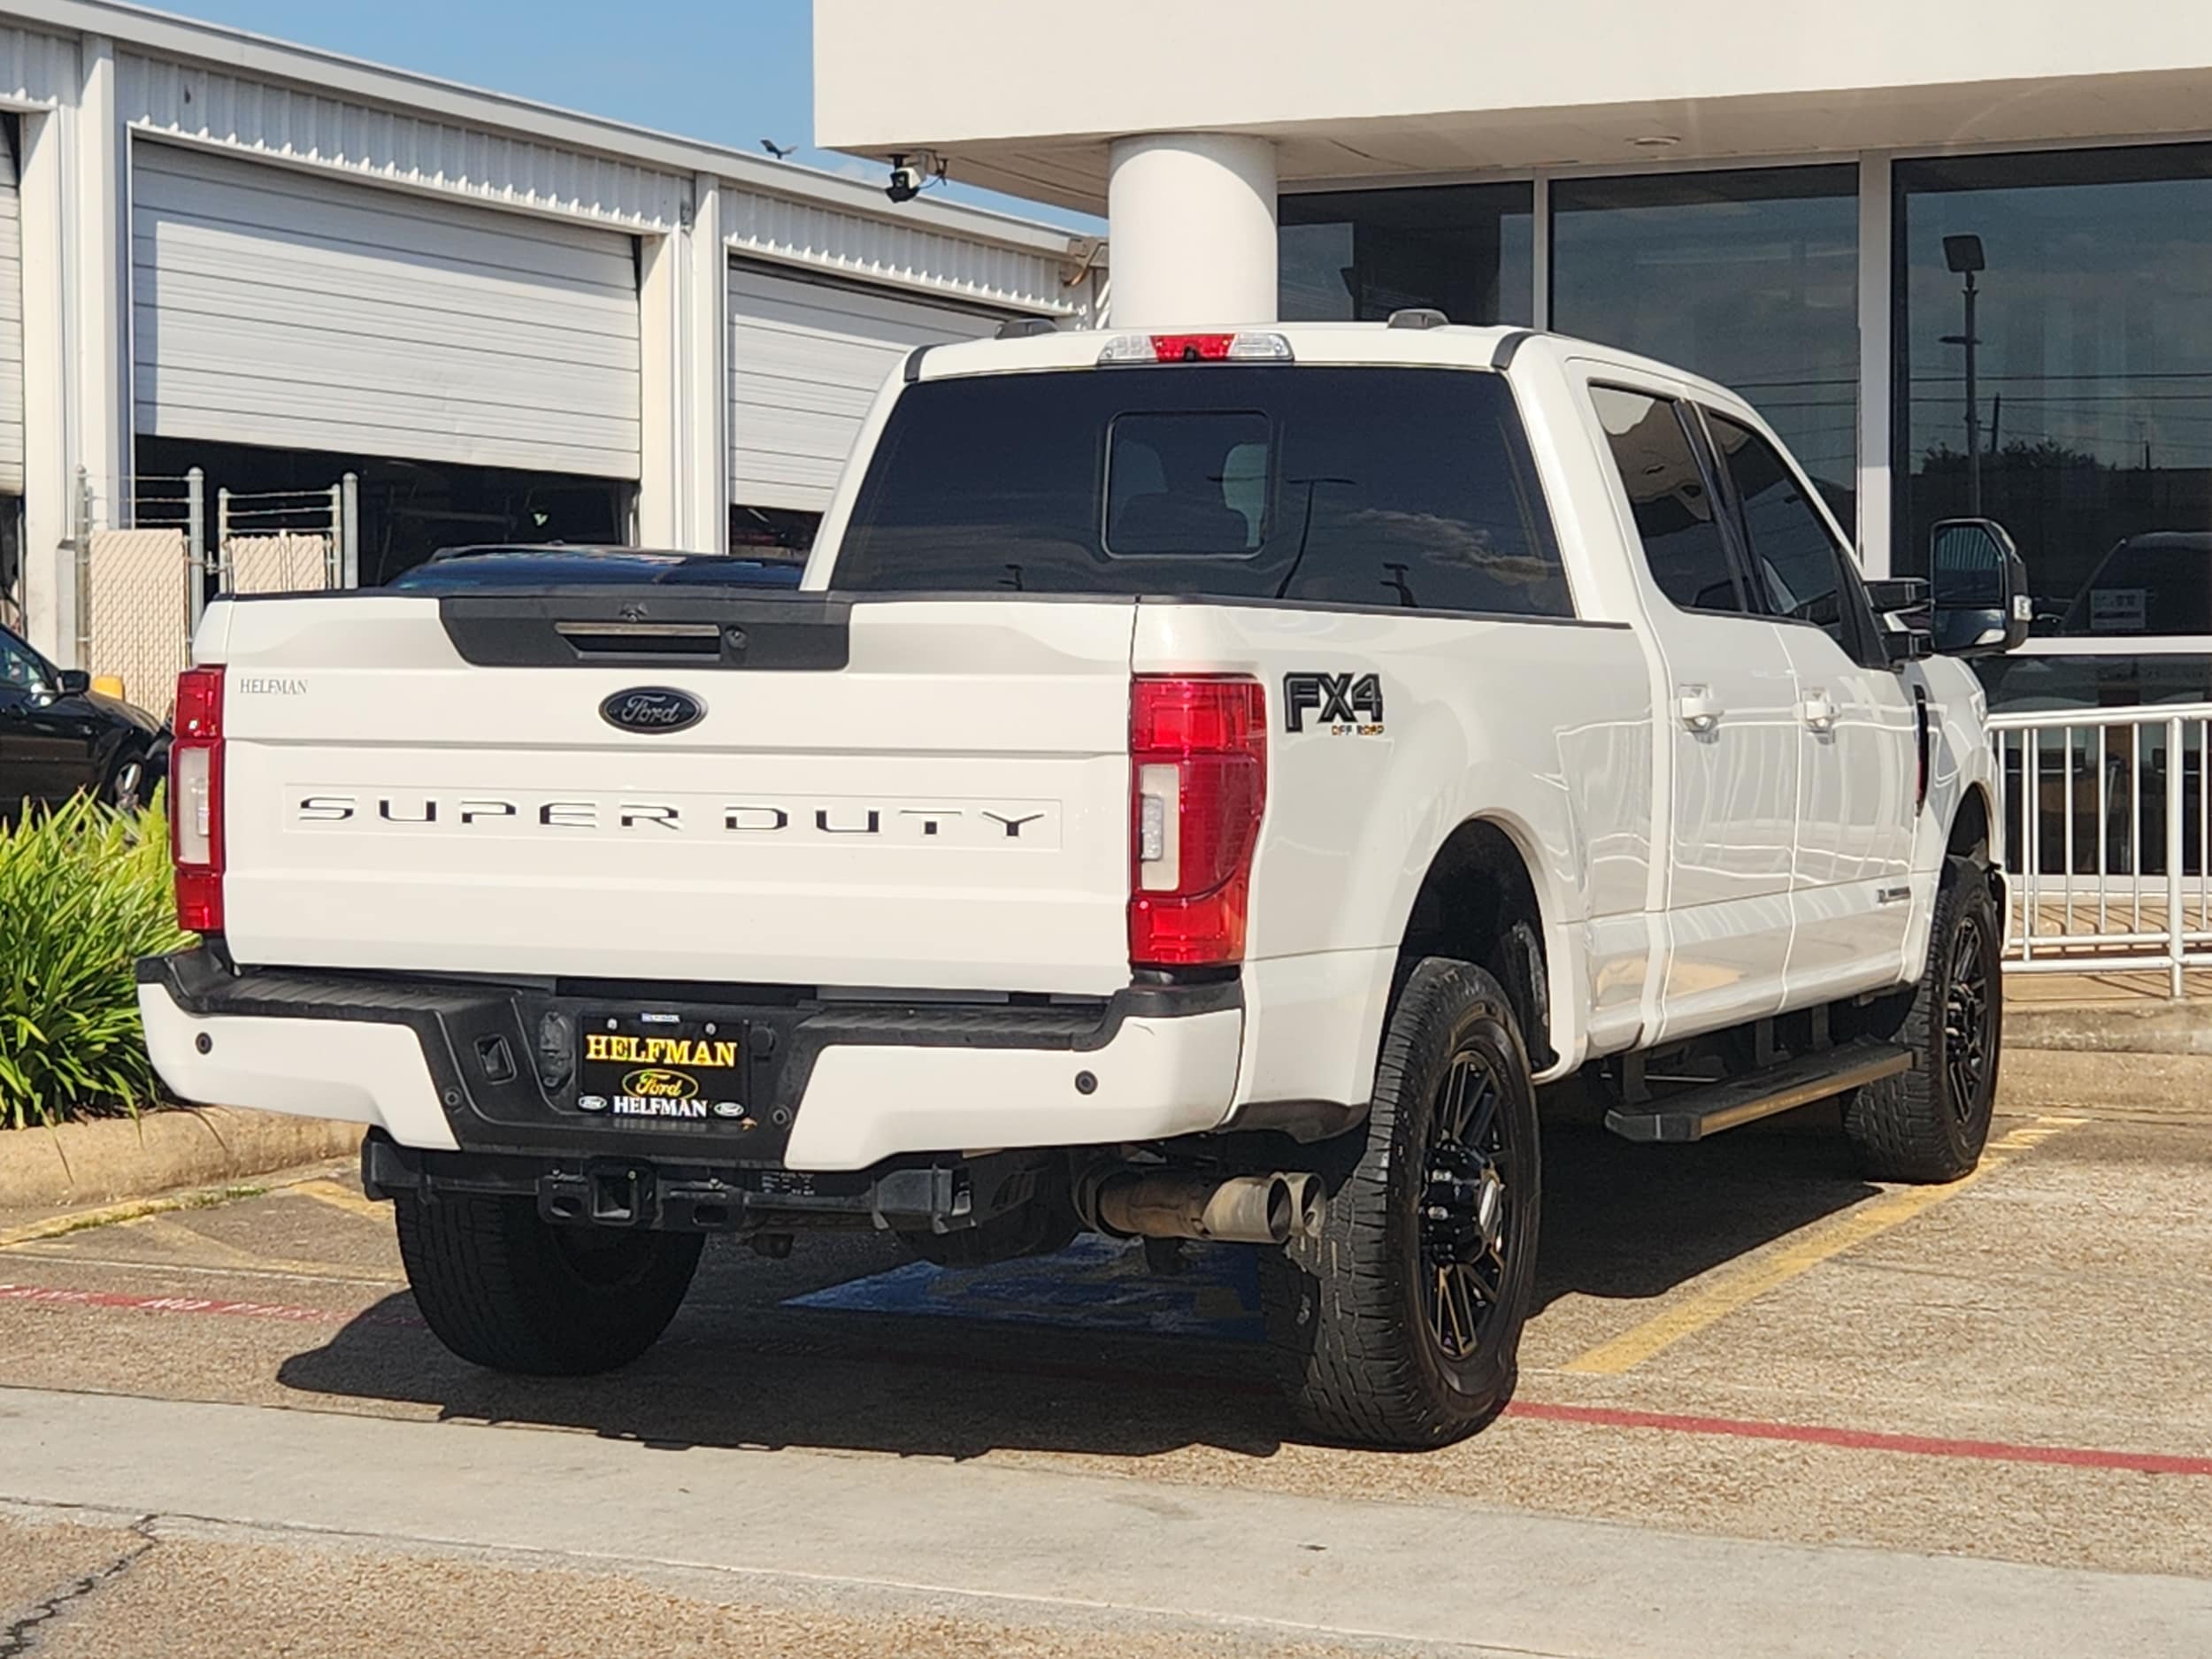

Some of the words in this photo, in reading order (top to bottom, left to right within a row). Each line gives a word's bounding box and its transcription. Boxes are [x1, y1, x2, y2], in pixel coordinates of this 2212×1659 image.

[239, 679, 309, 695] HELFMAN
[621, 695, 680, 722] Ford
[1283, 672, 1384, 733] FX4
[1331, 725, 1352, 735] OFF
[299, 796, 682, 833] SUPER
[725, 806, 1045, 837] DUTY
[586, 1034, 738, 1067] HELFMAN
[635, 1071, 682, 1097] Ford
[612, 1095, 708, 1118] HELFMAN
